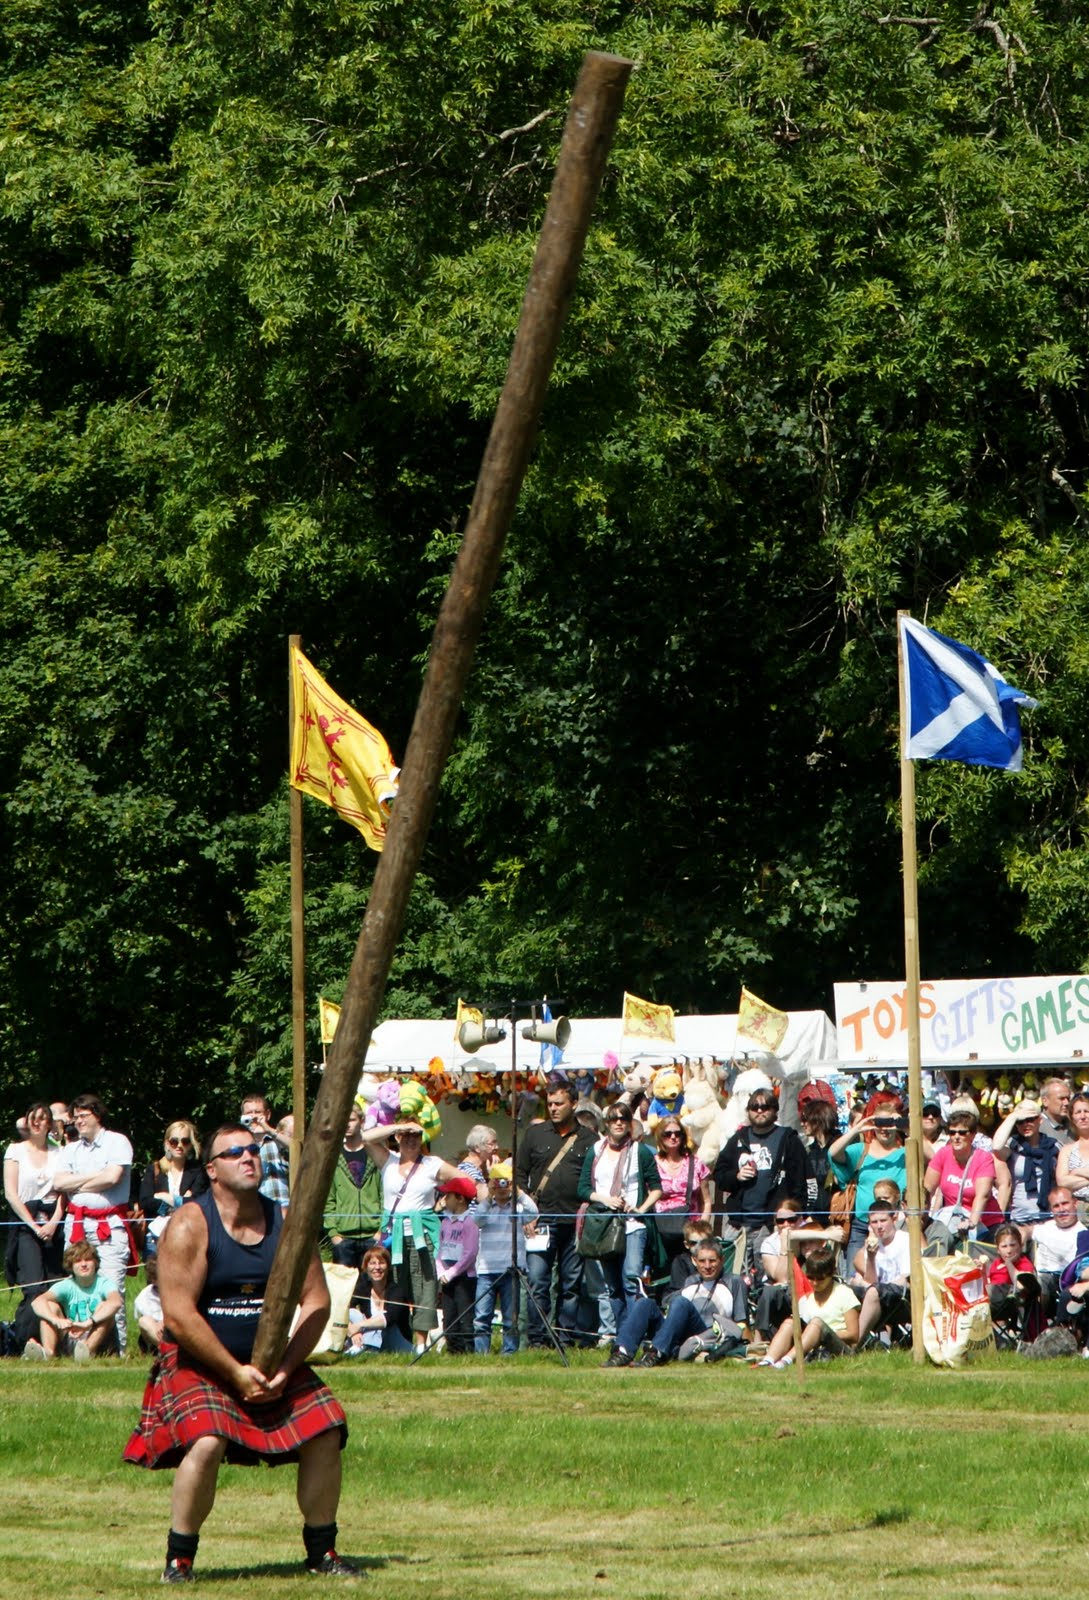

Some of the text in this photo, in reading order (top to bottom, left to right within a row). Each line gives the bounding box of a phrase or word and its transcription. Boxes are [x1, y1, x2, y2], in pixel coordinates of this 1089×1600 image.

[842, 978, 1089, 1053] TOYS GIFTS GAMES
